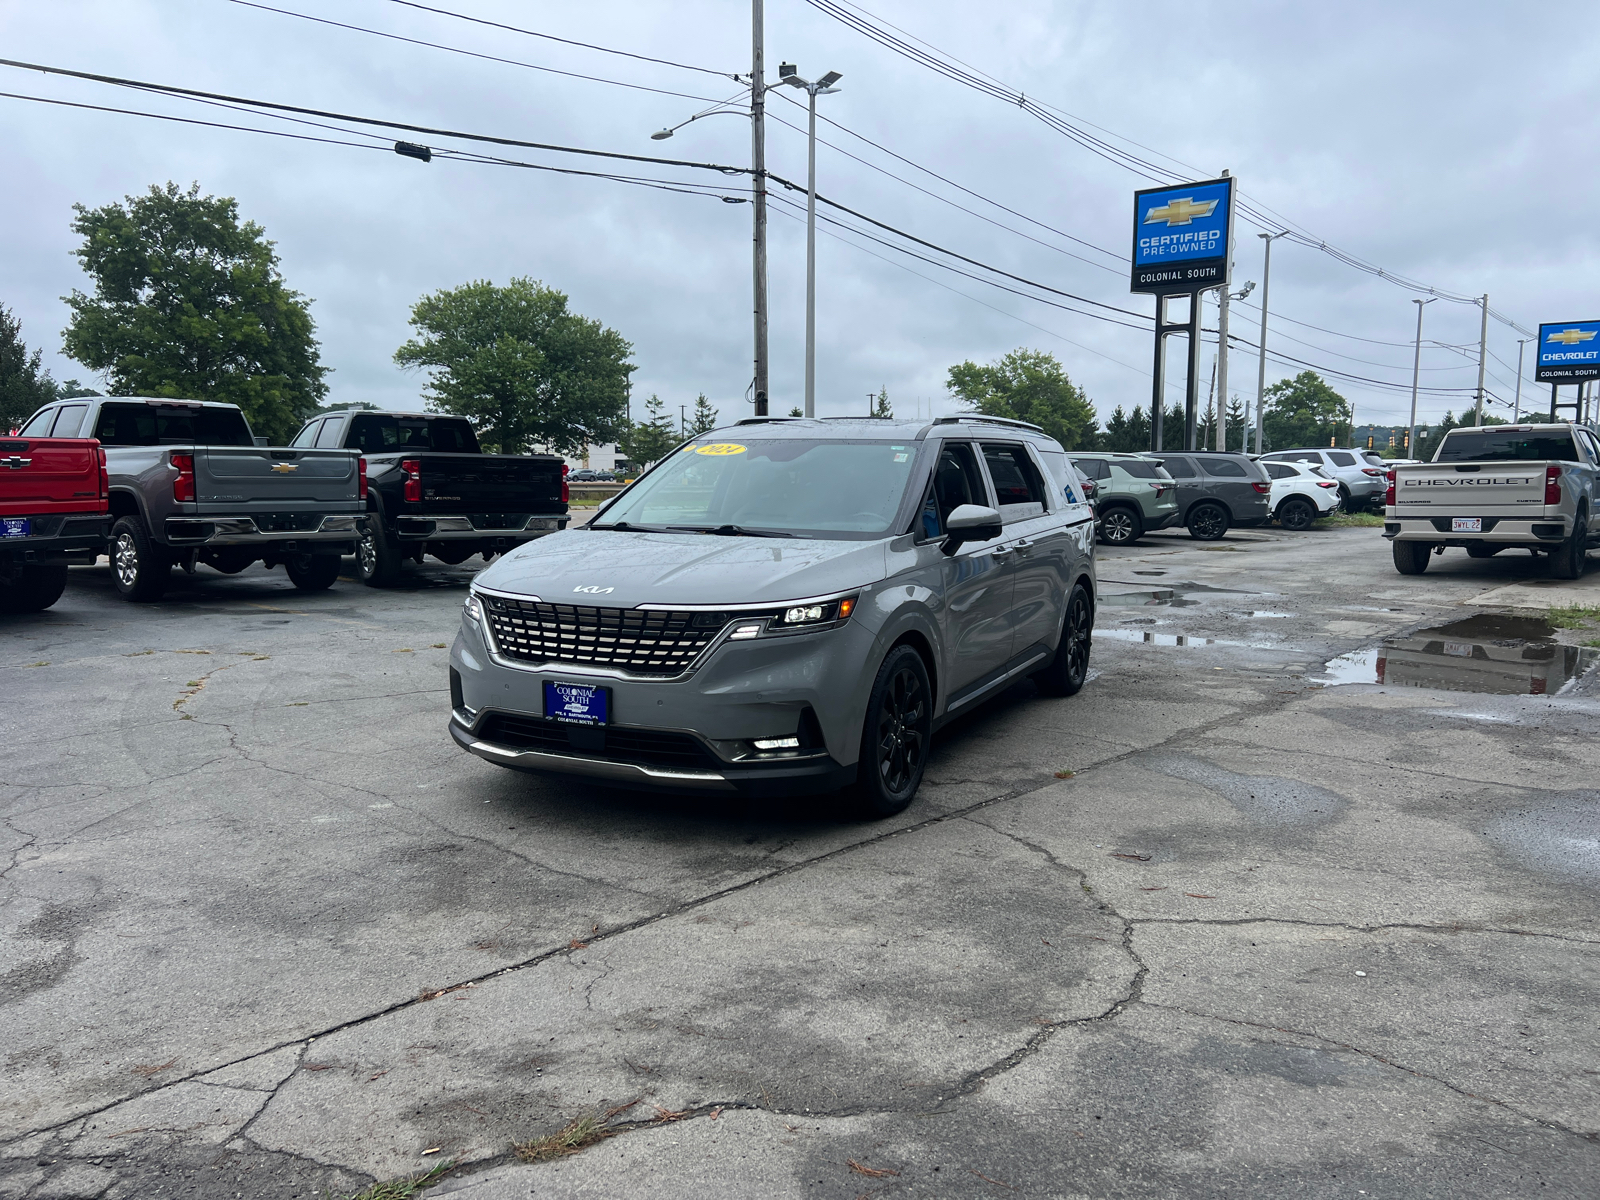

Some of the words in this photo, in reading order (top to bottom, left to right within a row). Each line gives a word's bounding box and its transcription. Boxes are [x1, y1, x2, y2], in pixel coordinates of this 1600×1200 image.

[1140, 230, 1220, 247] CERTIFIED
[1143, 241, 1216, 256] PRE-OWNED
[1140, 271, 1183, 283] COLONIAL
[1187, 268, 1216, 278] SOUTH
[1542, 351, 1599, 361] CHEVROLET
[700, 445, 743, 454] 2024
[1404, 478, 1535, 486] CHEVROLET
[1453, 521, 1470, 529] 3WYL
[1471, 521, 1480, 529] 22
[573, 585, 615, 595] KIA
[556, 687, 595, 698] COLONIAL
[562, 695, 589, 704] SOUTH
